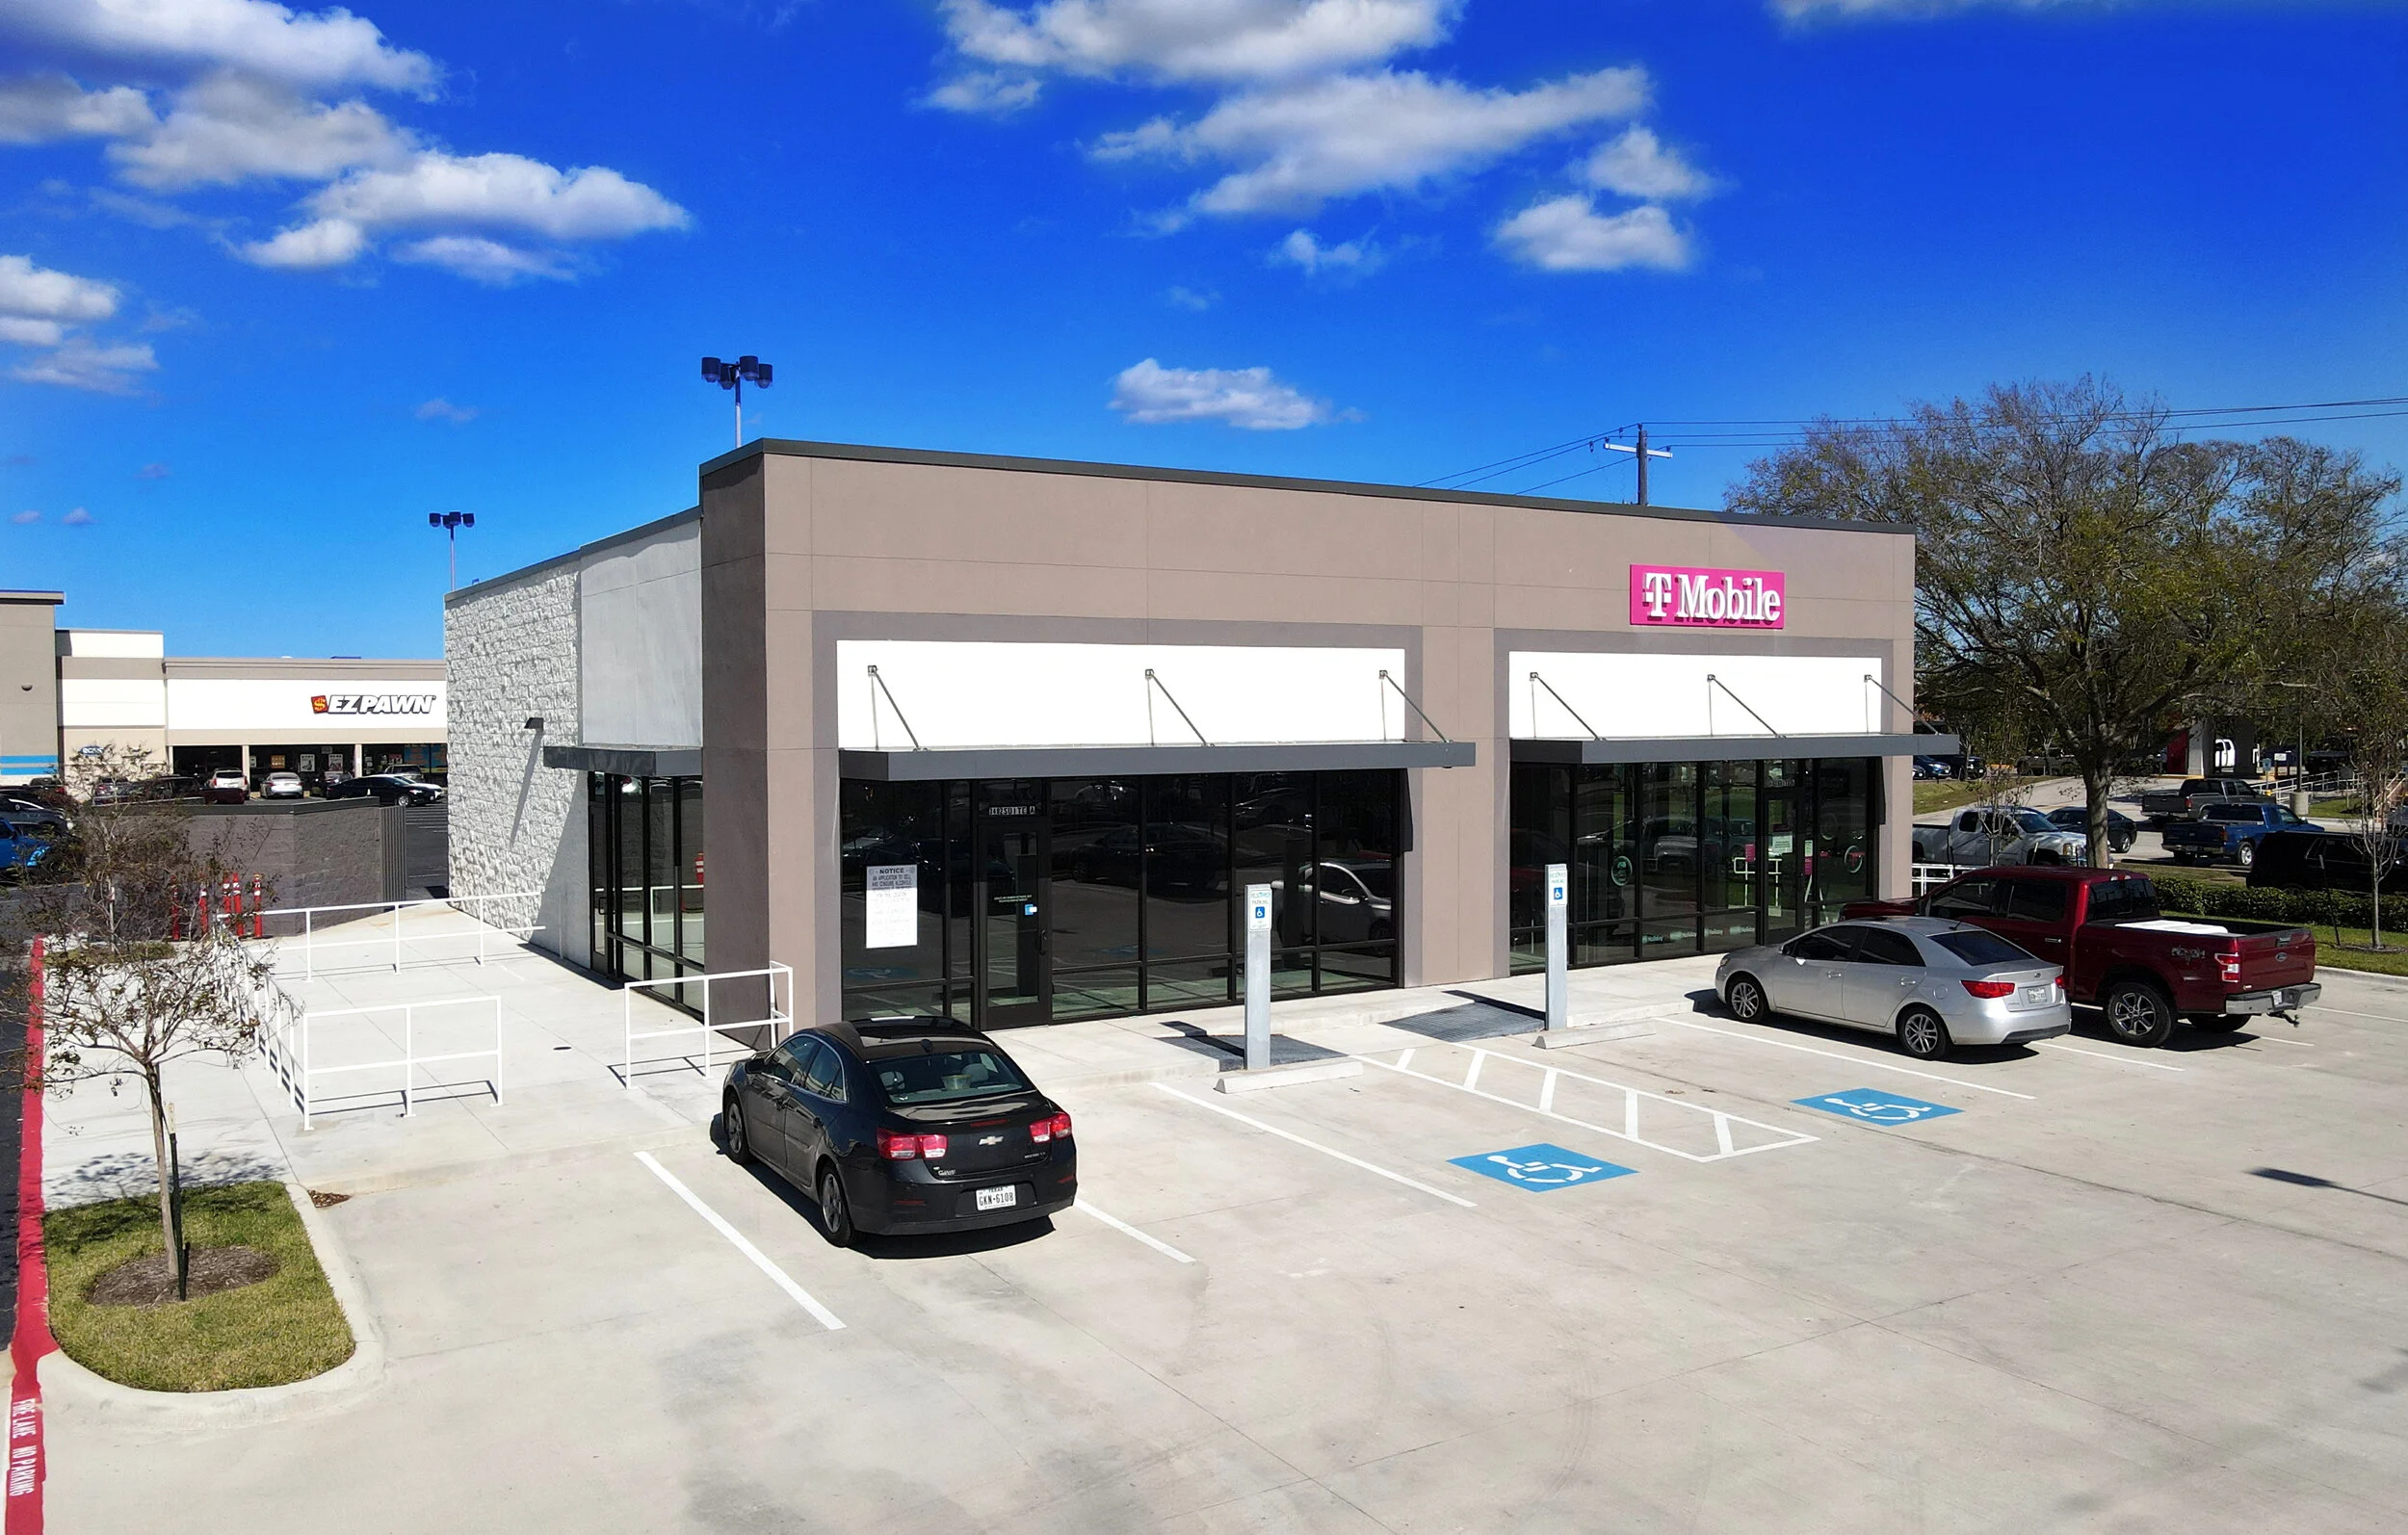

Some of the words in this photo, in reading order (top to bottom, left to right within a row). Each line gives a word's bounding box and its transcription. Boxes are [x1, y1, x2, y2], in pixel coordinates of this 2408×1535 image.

[1676, 574, 1781, 621] Mobile
[13, 1398, 36, 1418] FIRE
[13, 1416, 37, 1439] LANE
[13, 1445, 38, 1459] NO
[10, 1458, 38, 1496] PARKING
